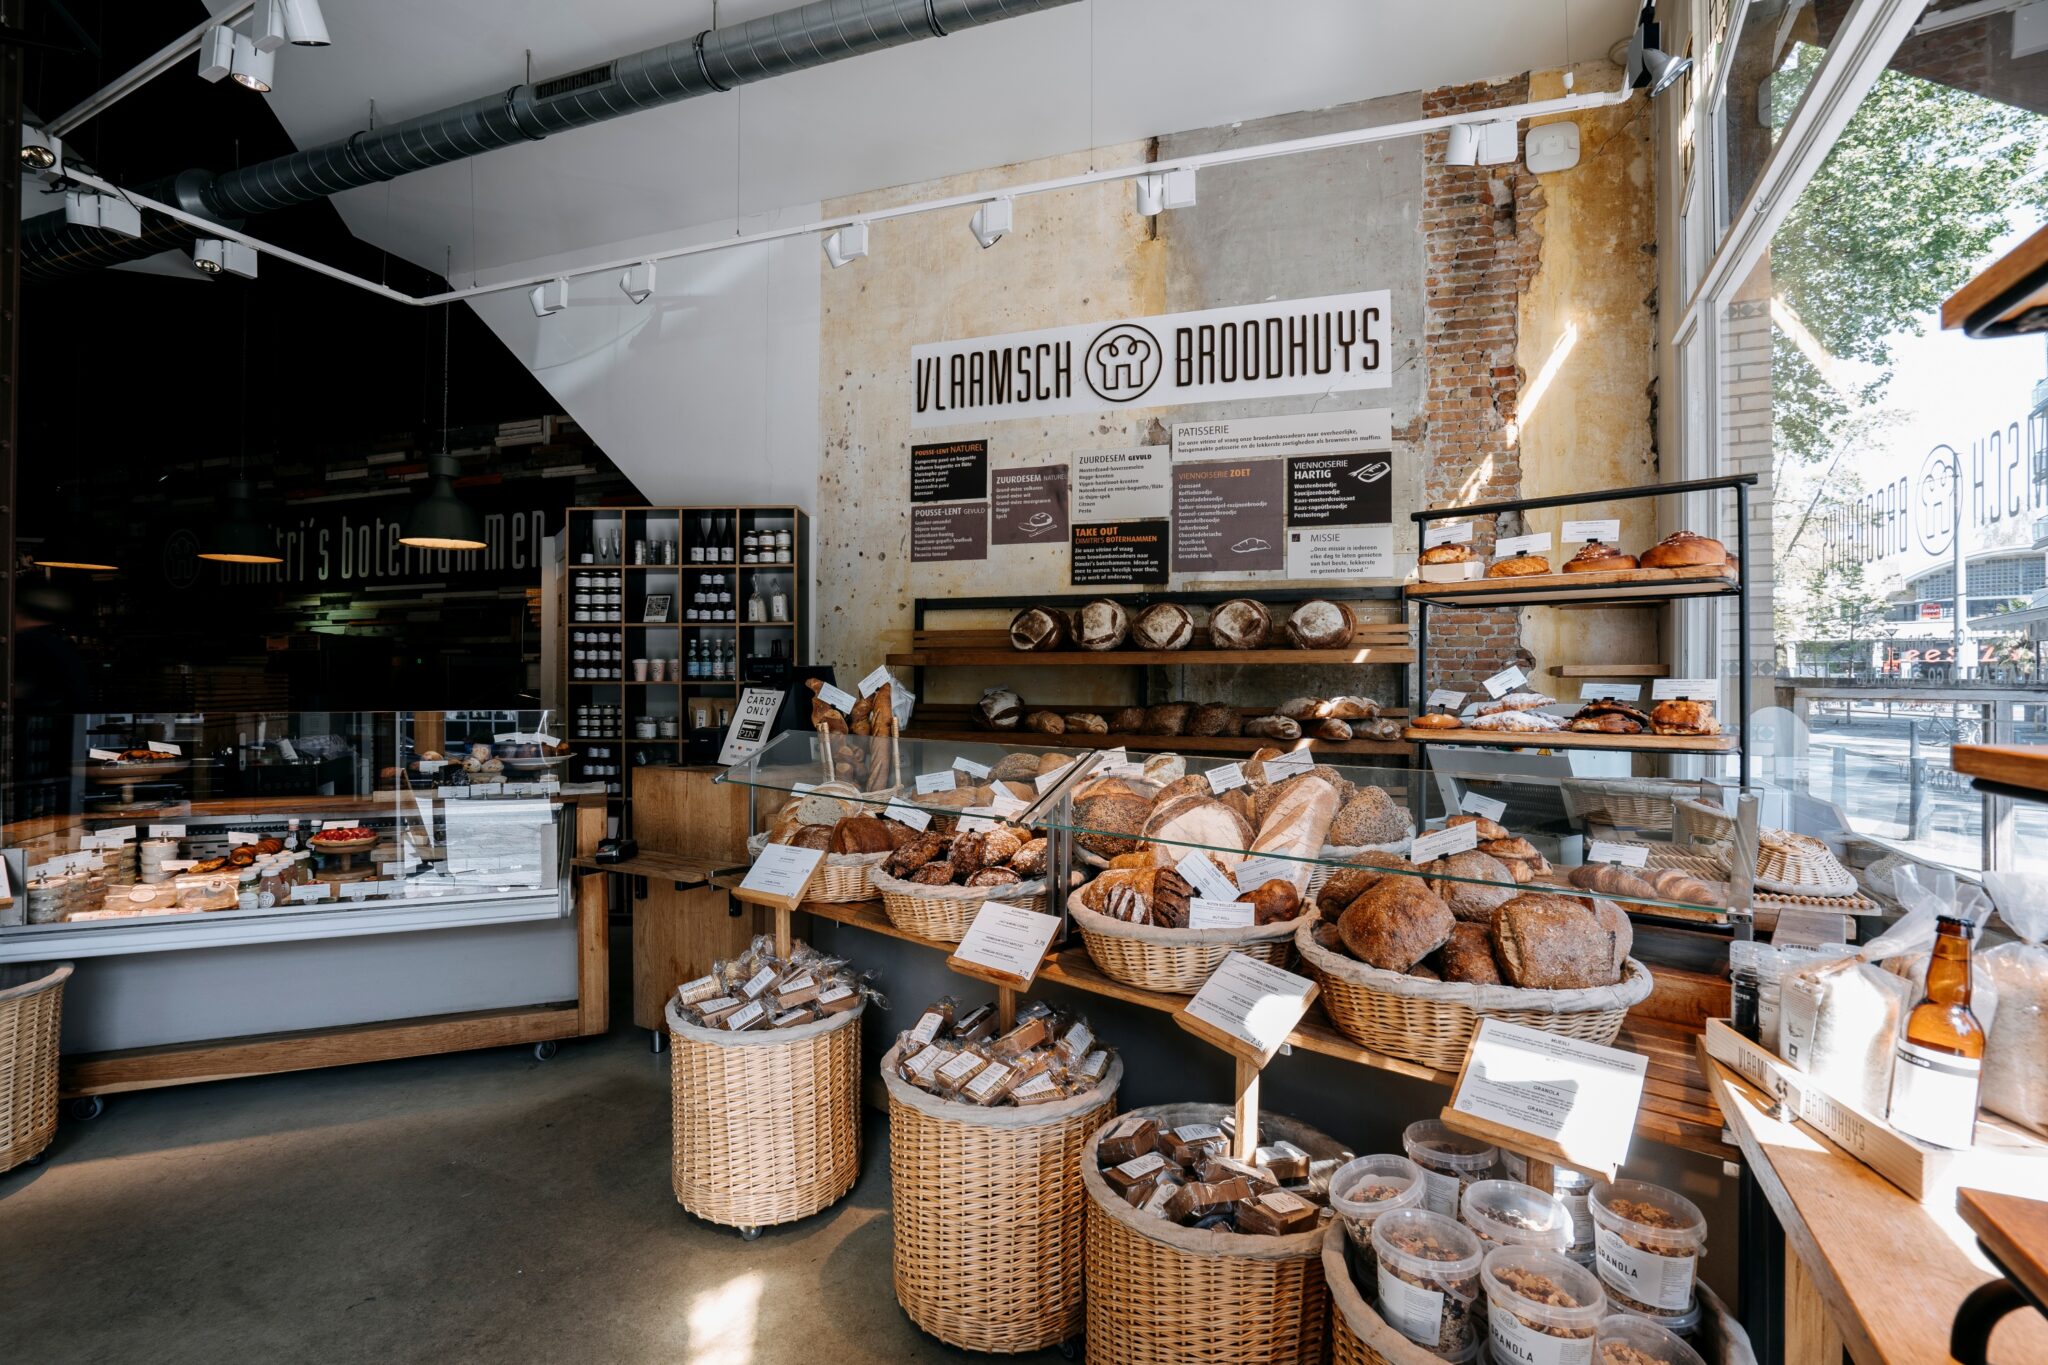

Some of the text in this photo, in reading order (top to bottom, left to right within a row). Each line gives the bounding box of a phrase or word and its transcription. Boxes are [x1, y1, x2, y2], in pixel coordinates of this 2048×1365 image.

[916, 307, 1380, 413] VLAAMSCH BROODHUYS
[1179, 425, 1229, 437] PATISSERIE
[950, 444, 983, 453] NATUREL
[1079, 454, 1125, 464] ZUURDESEM
[1294, 460, 1348, 470] VIENNOISERIE
[996, 474, 1041, 484] ZUURDESEM
[1179, 469, 1251, 480] VIENNOISERIE ZOET
[1294, 470, 1332, 480] HARTIG
[915, 508, 961, 517] POUSSE-LENT
[1076, 527, 1118, 536] TAKE OUT
[1311, 534, 1340, 542] MISSIE
[747, 696, 776, 706] CARDS
[747, 706, 770, 716] ONLY
[739, 729, 755, 738] PIN
[1550, 1038, 1571, 1046] MUESLI
[1533, 1084, 1560, 1097] GRANOLA
[1527, 1105, 1554, 1117] GRANOLA
[1805, 1090, 1865, 1152] BROODHUYS
[1598, 1246, 1638, 1279] GRANOLA
[1490, 1324, 1534, 1363] GRANOLA
